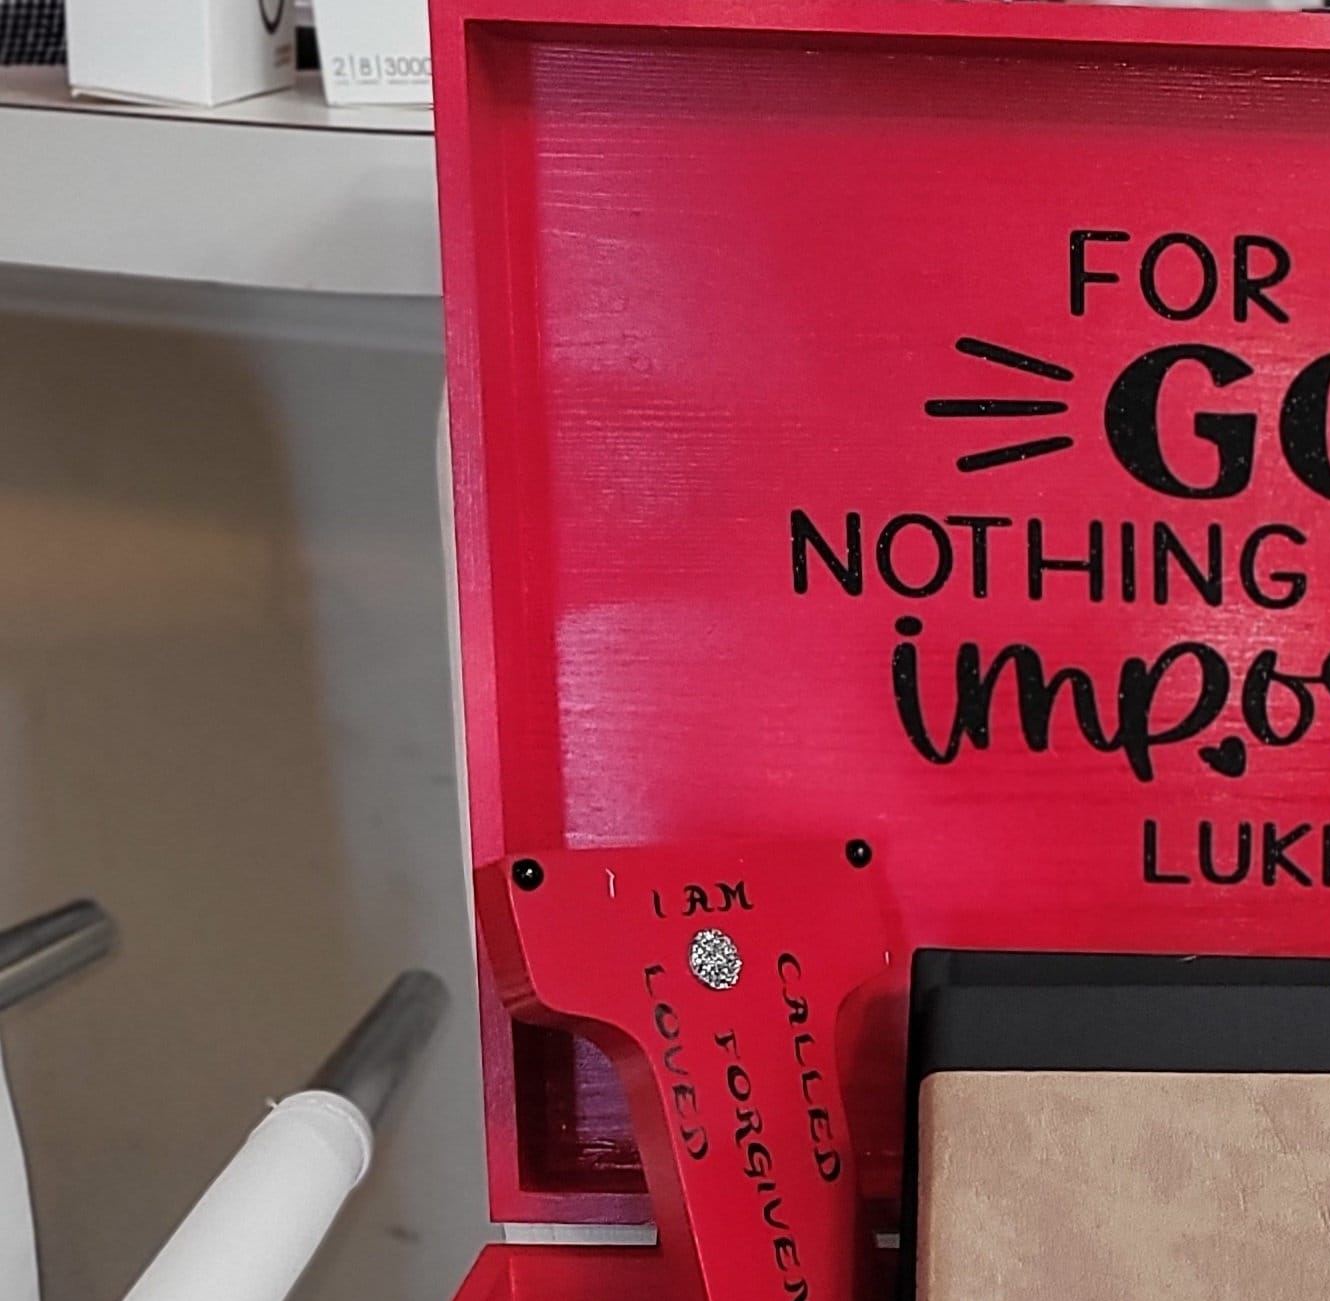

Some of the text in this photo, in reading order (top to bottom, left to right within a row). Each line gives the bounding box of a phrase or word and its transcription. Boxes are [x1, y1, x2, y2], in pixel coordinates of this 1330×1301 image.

[1069, 230, 1291, 323] FOR
[789, 510, 1308, 609] NOTHING
[653, 881, 753, 918] I AM
[644, 964, 708, 1160] LOVED
[777, 953, 841, 1182] CALLED
